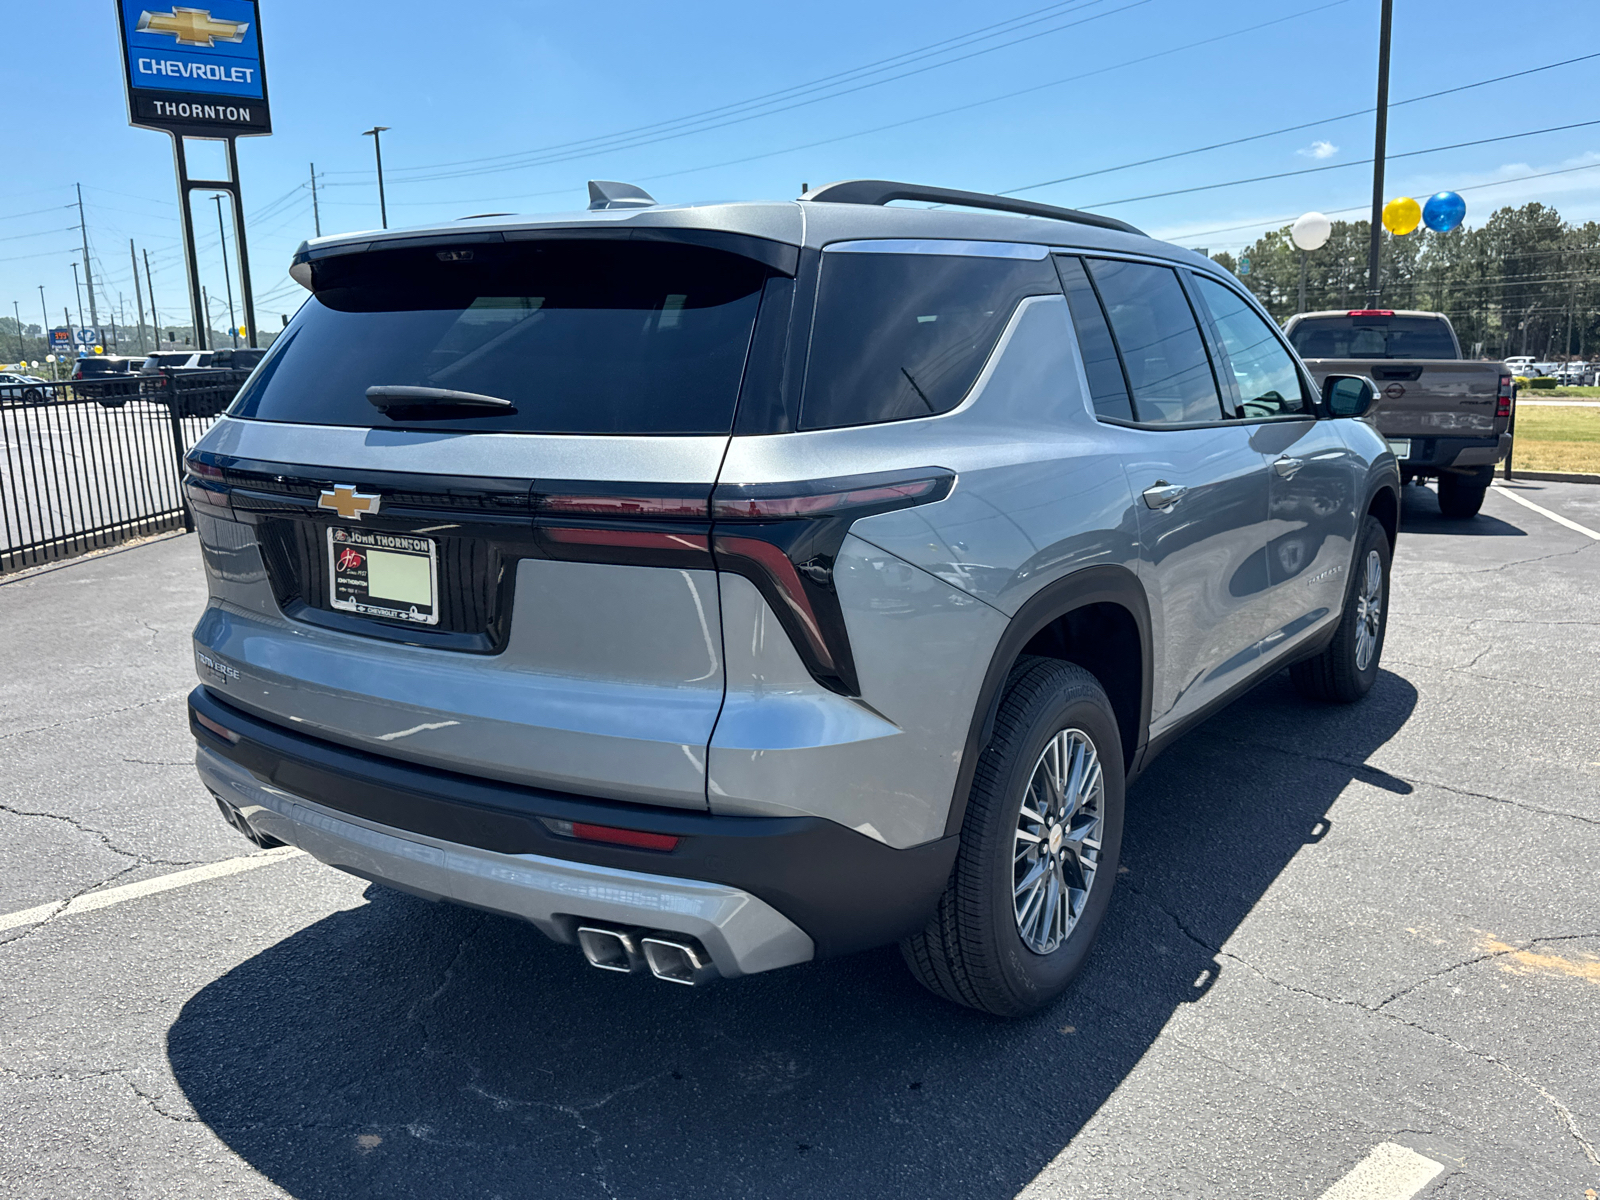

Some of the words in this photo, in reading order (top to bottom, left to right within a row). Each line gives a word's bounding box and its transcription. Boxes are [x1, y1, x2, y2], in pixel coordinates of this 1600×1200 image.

[138, 58, 254, 84] CHEVROLET
[153, 101, 251, 122] THORNTON
[350, 532, 375, 545] JOHN
[376, 536, 429, 551] THORNTON
[367, 607, 398, 617] CHEVROLET
